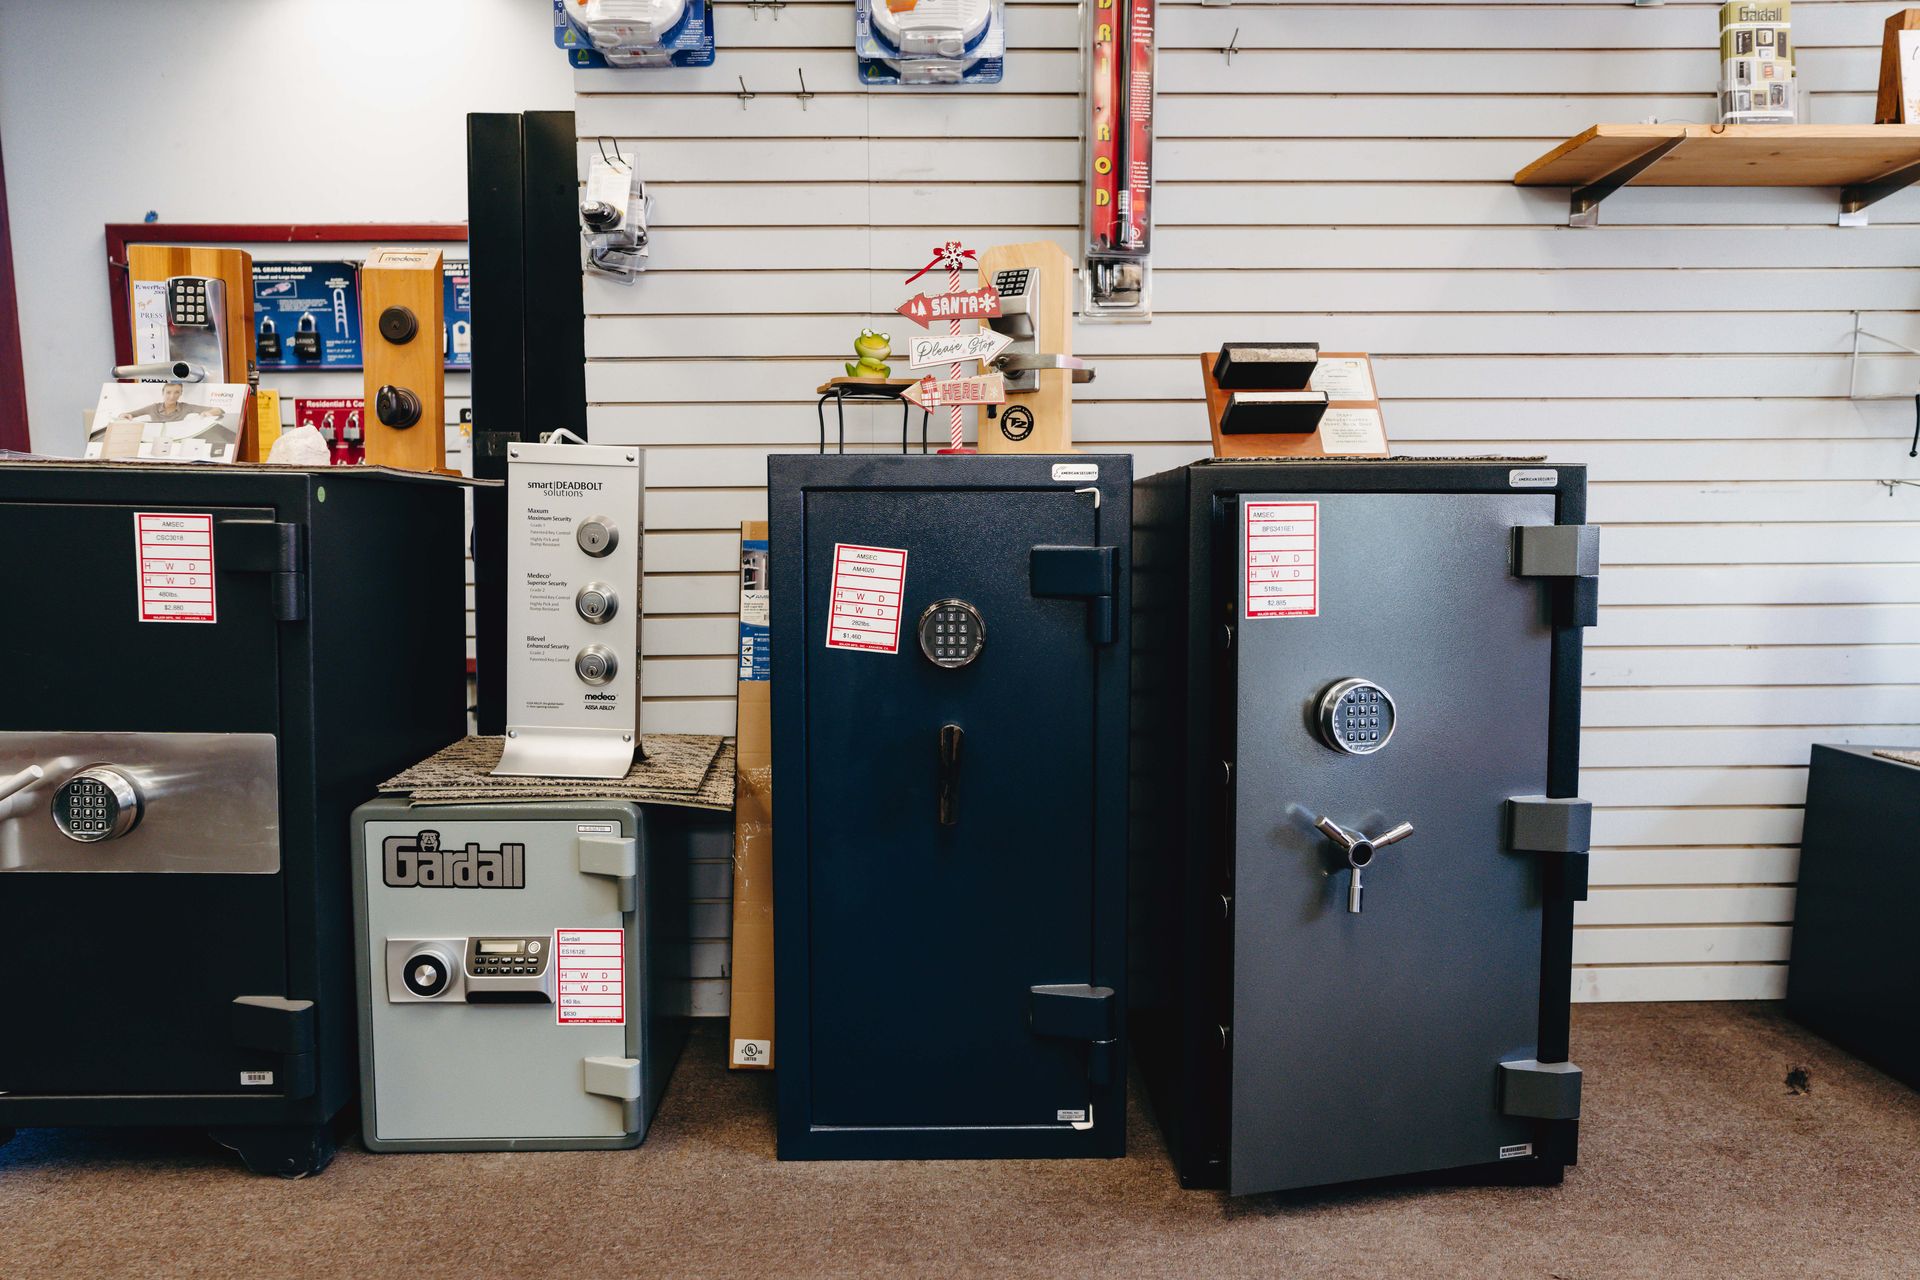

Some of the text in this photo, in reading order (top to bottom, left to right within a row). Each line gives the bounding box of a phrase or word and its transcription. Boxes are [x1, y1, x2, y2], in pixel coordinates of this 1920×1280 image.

[1739, 7, 1782, 21] Gardall
[931, 295, 979, 317] SANTA
[916, 336, 996, 363] Please Stop
[942, 383, 987, 401] HERE!
[306, 400, 345, 408] Residential
[527, 481, 603, 491] smart DEADBOLT
[543, 489, 584, 497] solutions
[856, 553, 878, 561] AMSEC
[1250, 554, 1300, 563] H W D
[145, 562, 151, 570] H
[189, 563, 196, 571] D
[852, 566, 875, 574] AM4020
[1270, 570, 1280, 578] W
[1293, 570, 1300, 578] D
[190, 577, 196, 585] D
[856, 593, 865, 601] W
[878, 595, 885, 603] D
[855, 606, 864, 614] W
[877, 608, 884, 616] D
[550, 643, 569, 651] Security
[584, 691, 616, 701] medeco
[382, 835, 526, 889] Gardall
